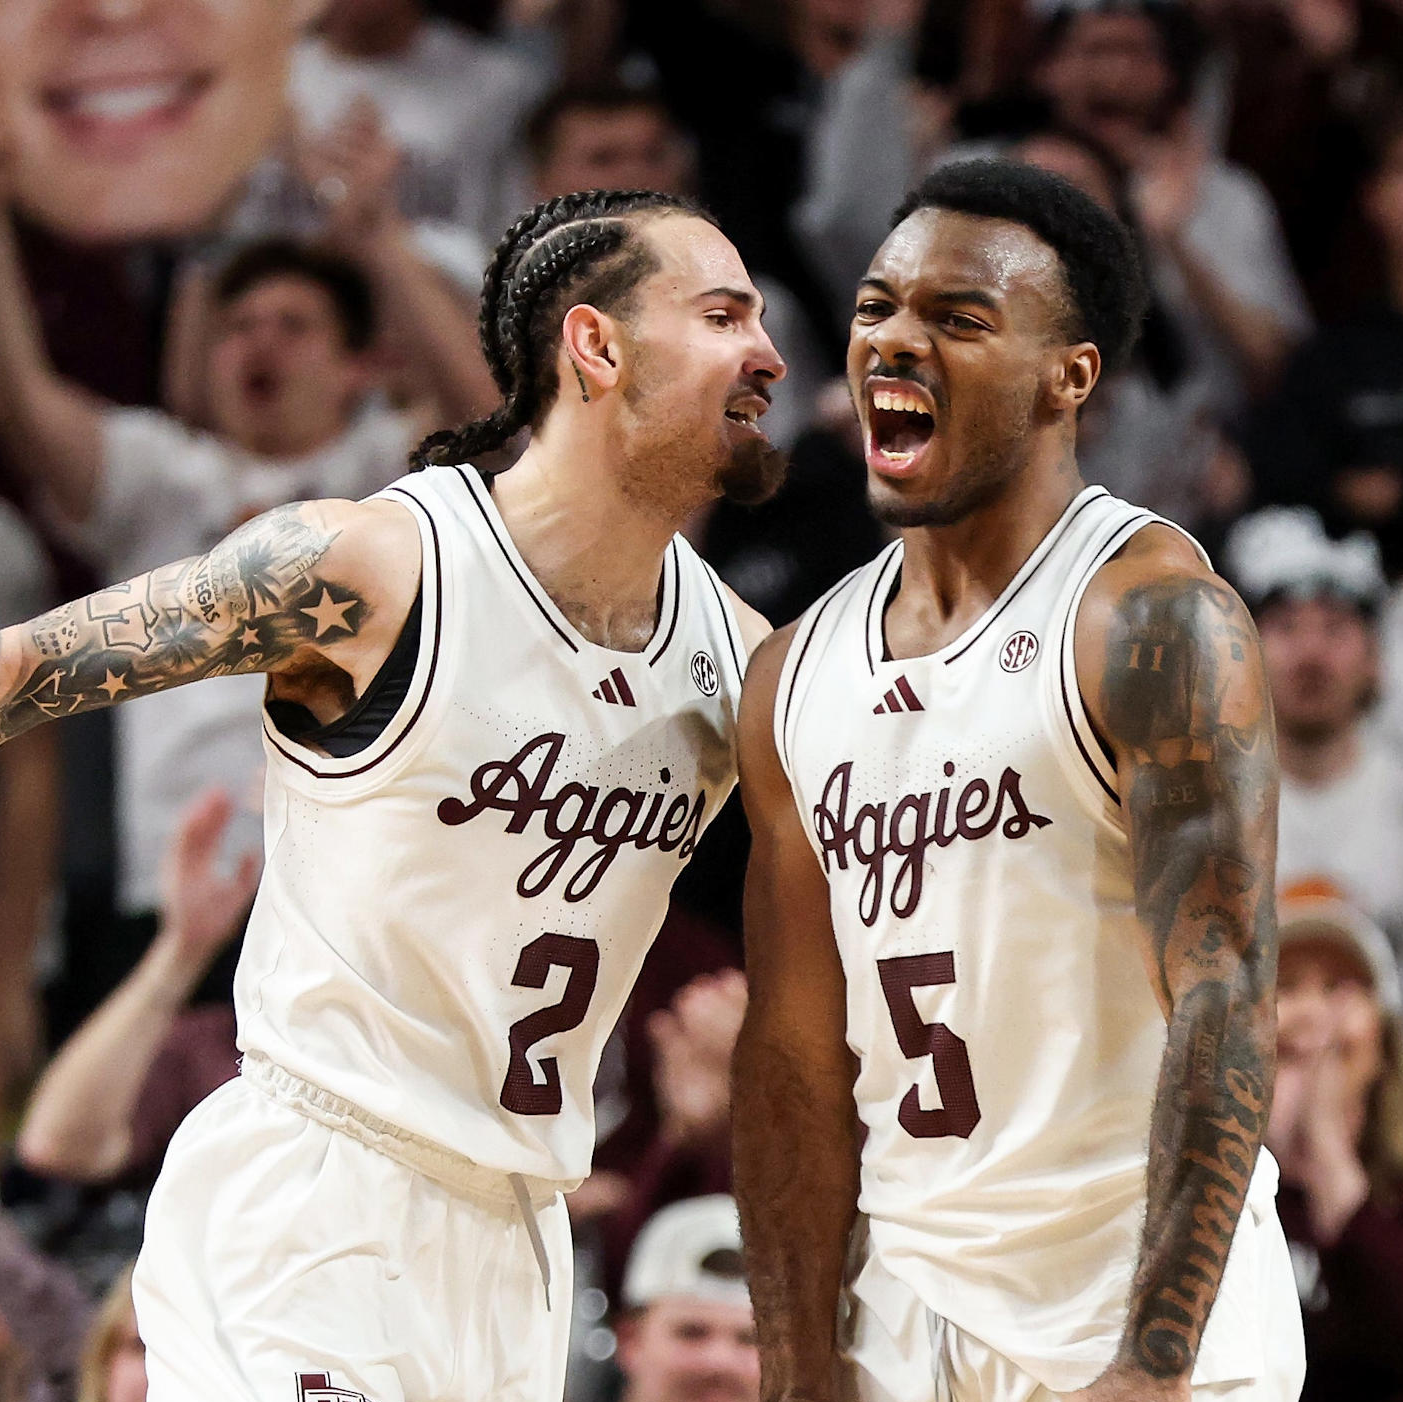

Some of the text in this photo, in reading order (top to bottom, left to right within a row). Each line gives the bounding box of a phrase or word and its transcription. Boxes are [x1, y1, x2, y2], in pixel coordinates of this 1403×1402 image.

[194, 563, 222, 624] VEGAS
[692, 654, 716, 692] SEC
[1002, 633, 1036, 669] SEC
[437, 731, 707, 903] Aggies
[813, 760, 1054, 928] Aggies
[499, 931, 600, 1116] 2
[876, 950, 982, 1140] 5
